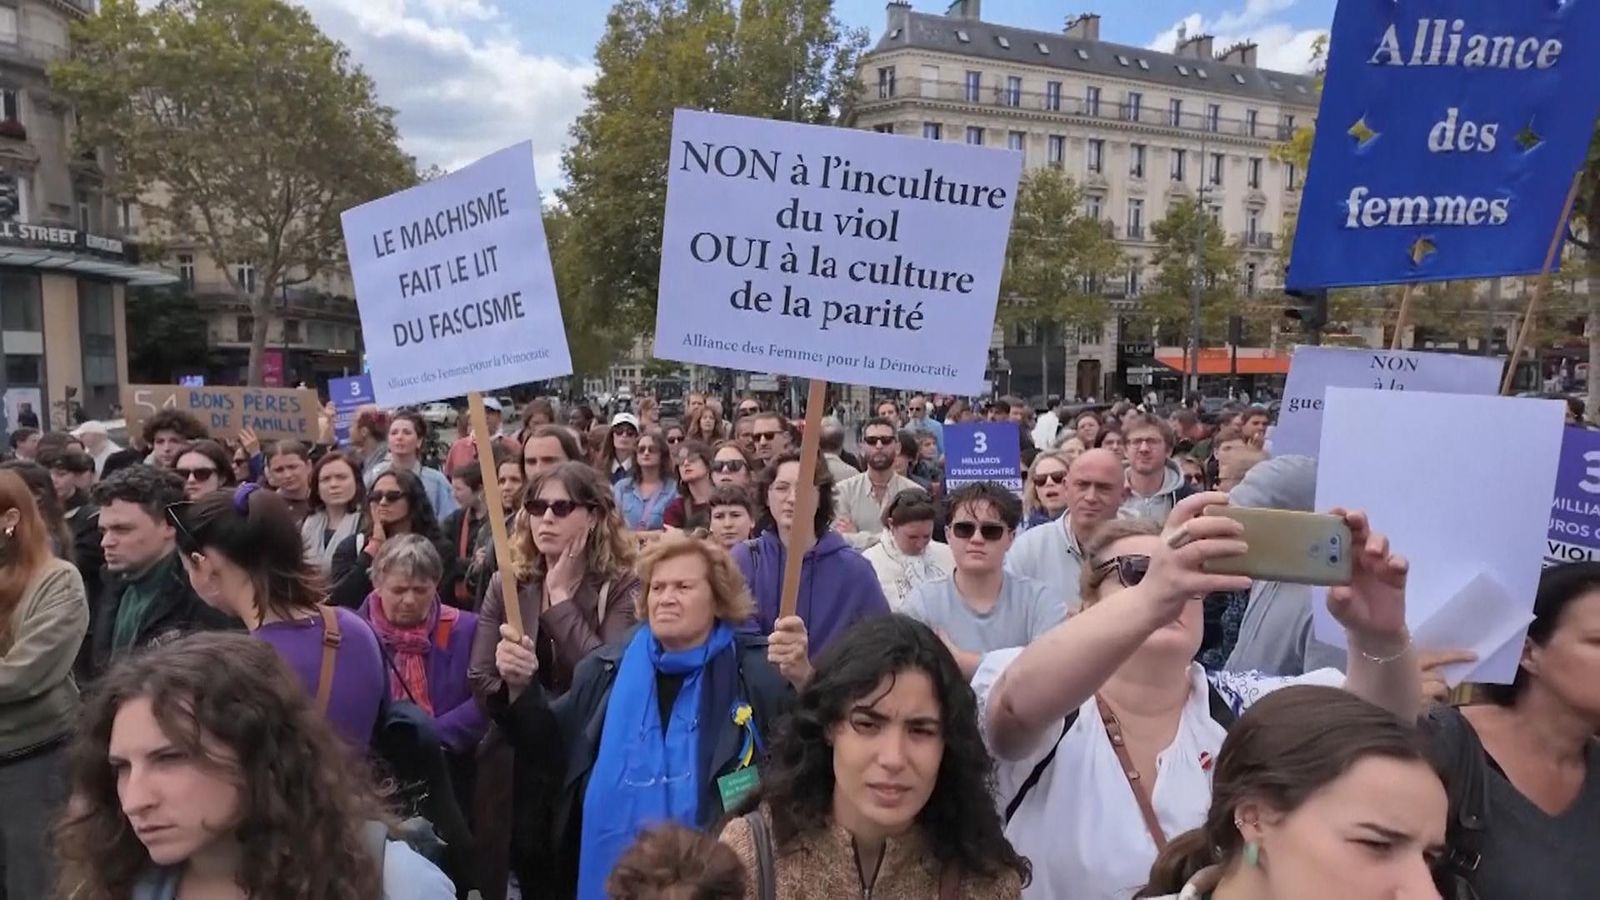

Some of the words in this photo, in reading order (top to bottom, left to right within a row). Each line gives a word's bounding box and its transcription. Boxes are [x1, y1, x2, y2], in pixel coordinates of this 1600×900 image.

[1366, 18, 1562, 70] Alliance
[1427, 107, 1499, 153] des
[680, 140, 781, 183] NON
[790, 154, 810, 186] à
[373, 229, 396, 258] LE
[399, 187, 510, 250] MACHISME
[776, 198, 822, 232] du
[834, 207, 899, 242] viol
[1344, 186, 1510, 228] femmes
[18, 223, 77, 244] STREET
[399, 264, 442, 298] FAIT
[447, 255, 469, 284] LE
[474, 245, 498, 278] LIT
[690, 232, 770, 271] OUI
[780, 243, 799, 274] à
[808, 245, 837, 279] la
[848, 255, 975, 294] culture
[393, 318, 424, 347] DU
[429, 291, 525, 340] FASCISME
[730, 280, 772, 313] de
[780, 286, 812, 318] la
[820, 300, 925, 331] parité
[421, 371, 437, 383] des
[468, 359, 492, 374] pour
[492, 356, 501, 367] la
[682, 333, 738, 352] Alliance
[741, 341, 764, 355] des
[768, 344, 823, 362] Femmes
[826, 354, 860, 367] pour
[863, 355, 875, 369] la
[880, 357, 958, 377] Démocratie
[1369, 355, 1419, 372] NON
[189, 392, 234, 410] BONS
[244, 388, 301, 413] PÈRES
[350, 381, 360, 396] 3
[1288, 397, 1325, 413] gue
[211, 414, 230, 429] DE
[242, 415, 306, 433] FAMILLE
[973, 431, 988, 453] 3
